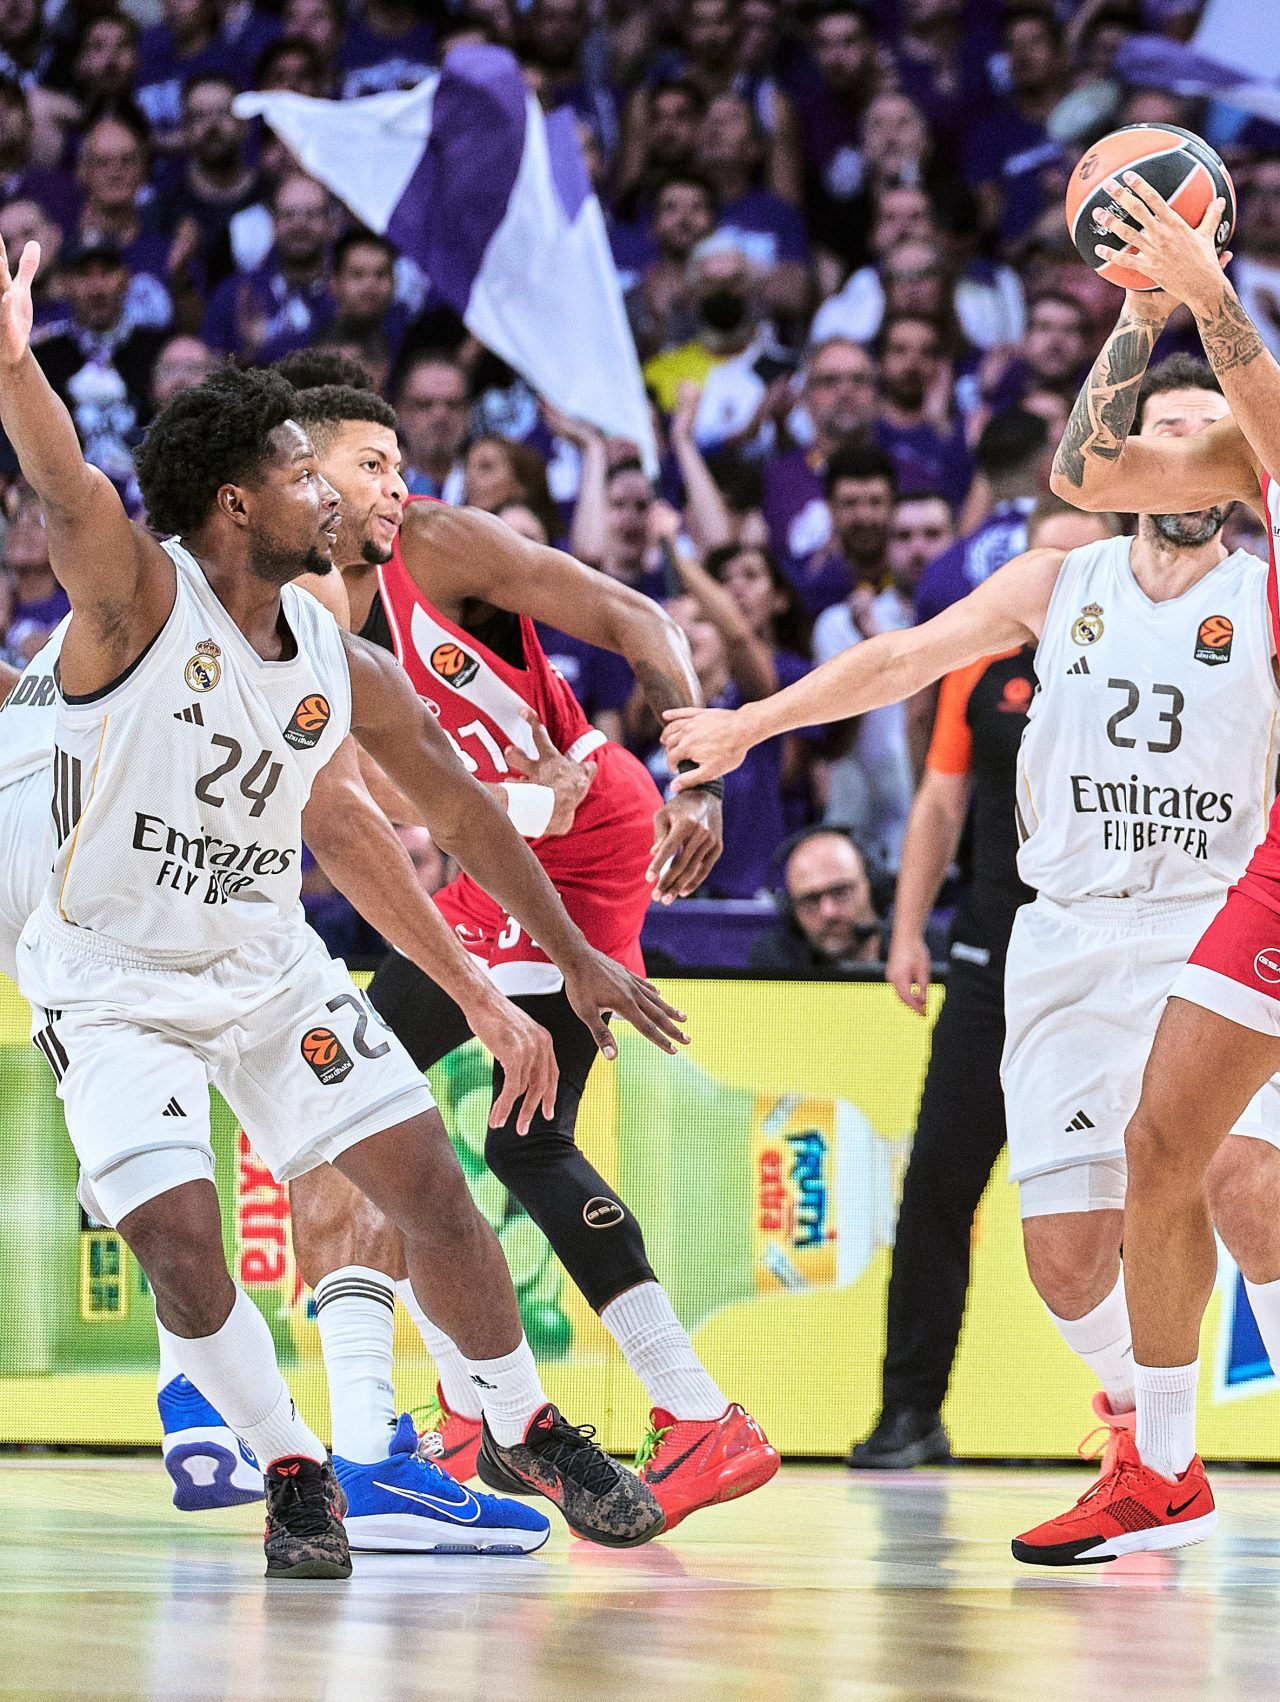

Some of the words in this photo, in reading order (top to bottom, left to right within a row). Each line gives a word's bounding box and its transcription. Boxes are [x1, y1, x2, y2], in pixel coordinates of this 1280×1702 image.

[1107, 678, 1184, 753] 23
[195, 733, 284, 817] 24
[1071, 774, 1233, 823] Emirates
[156, 860, 199, 896] FLY
